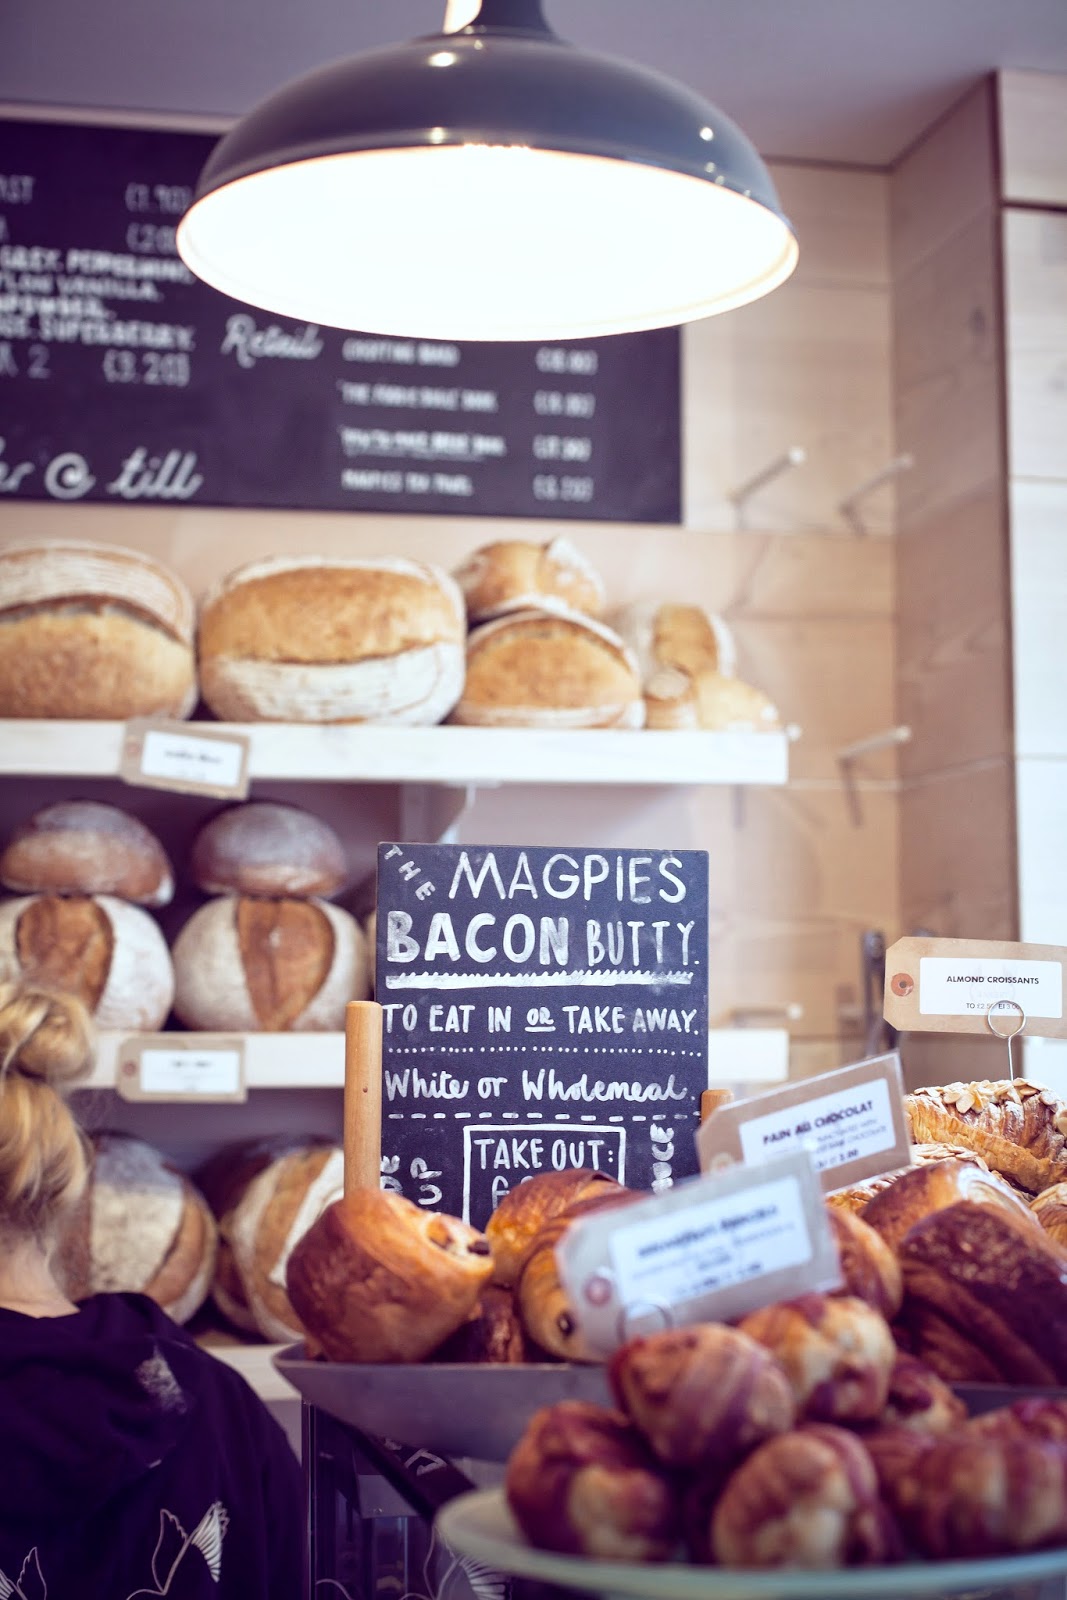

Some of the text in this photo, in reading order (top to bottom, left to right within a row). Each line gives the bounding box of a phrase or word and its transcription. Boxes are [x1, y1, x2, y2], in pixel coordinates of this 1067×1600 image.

[106, 447, 203, 500] till
[384, 845, 687, 904] THE MAGPIES
[387, 911, 700, 967] BACON BUTTY.
[946, 975, 1040, 985] ALMOND CROISSANTS
[382, 1004, 418, 1033] TO
[429, 1004, 475, 1033] EAT
[488, 1006, 512, 1033] IN
[562, 1006, 626, 1034] TAKE
[632, 1008, 700, 1036] AWAY.
[384, 1068, 470, 1101] White
[478, 1076, 508, 1099] or
[762, 1128, 791, 1145] PAIN
[474, 1138, 614, 1171] TAKE OUT:
